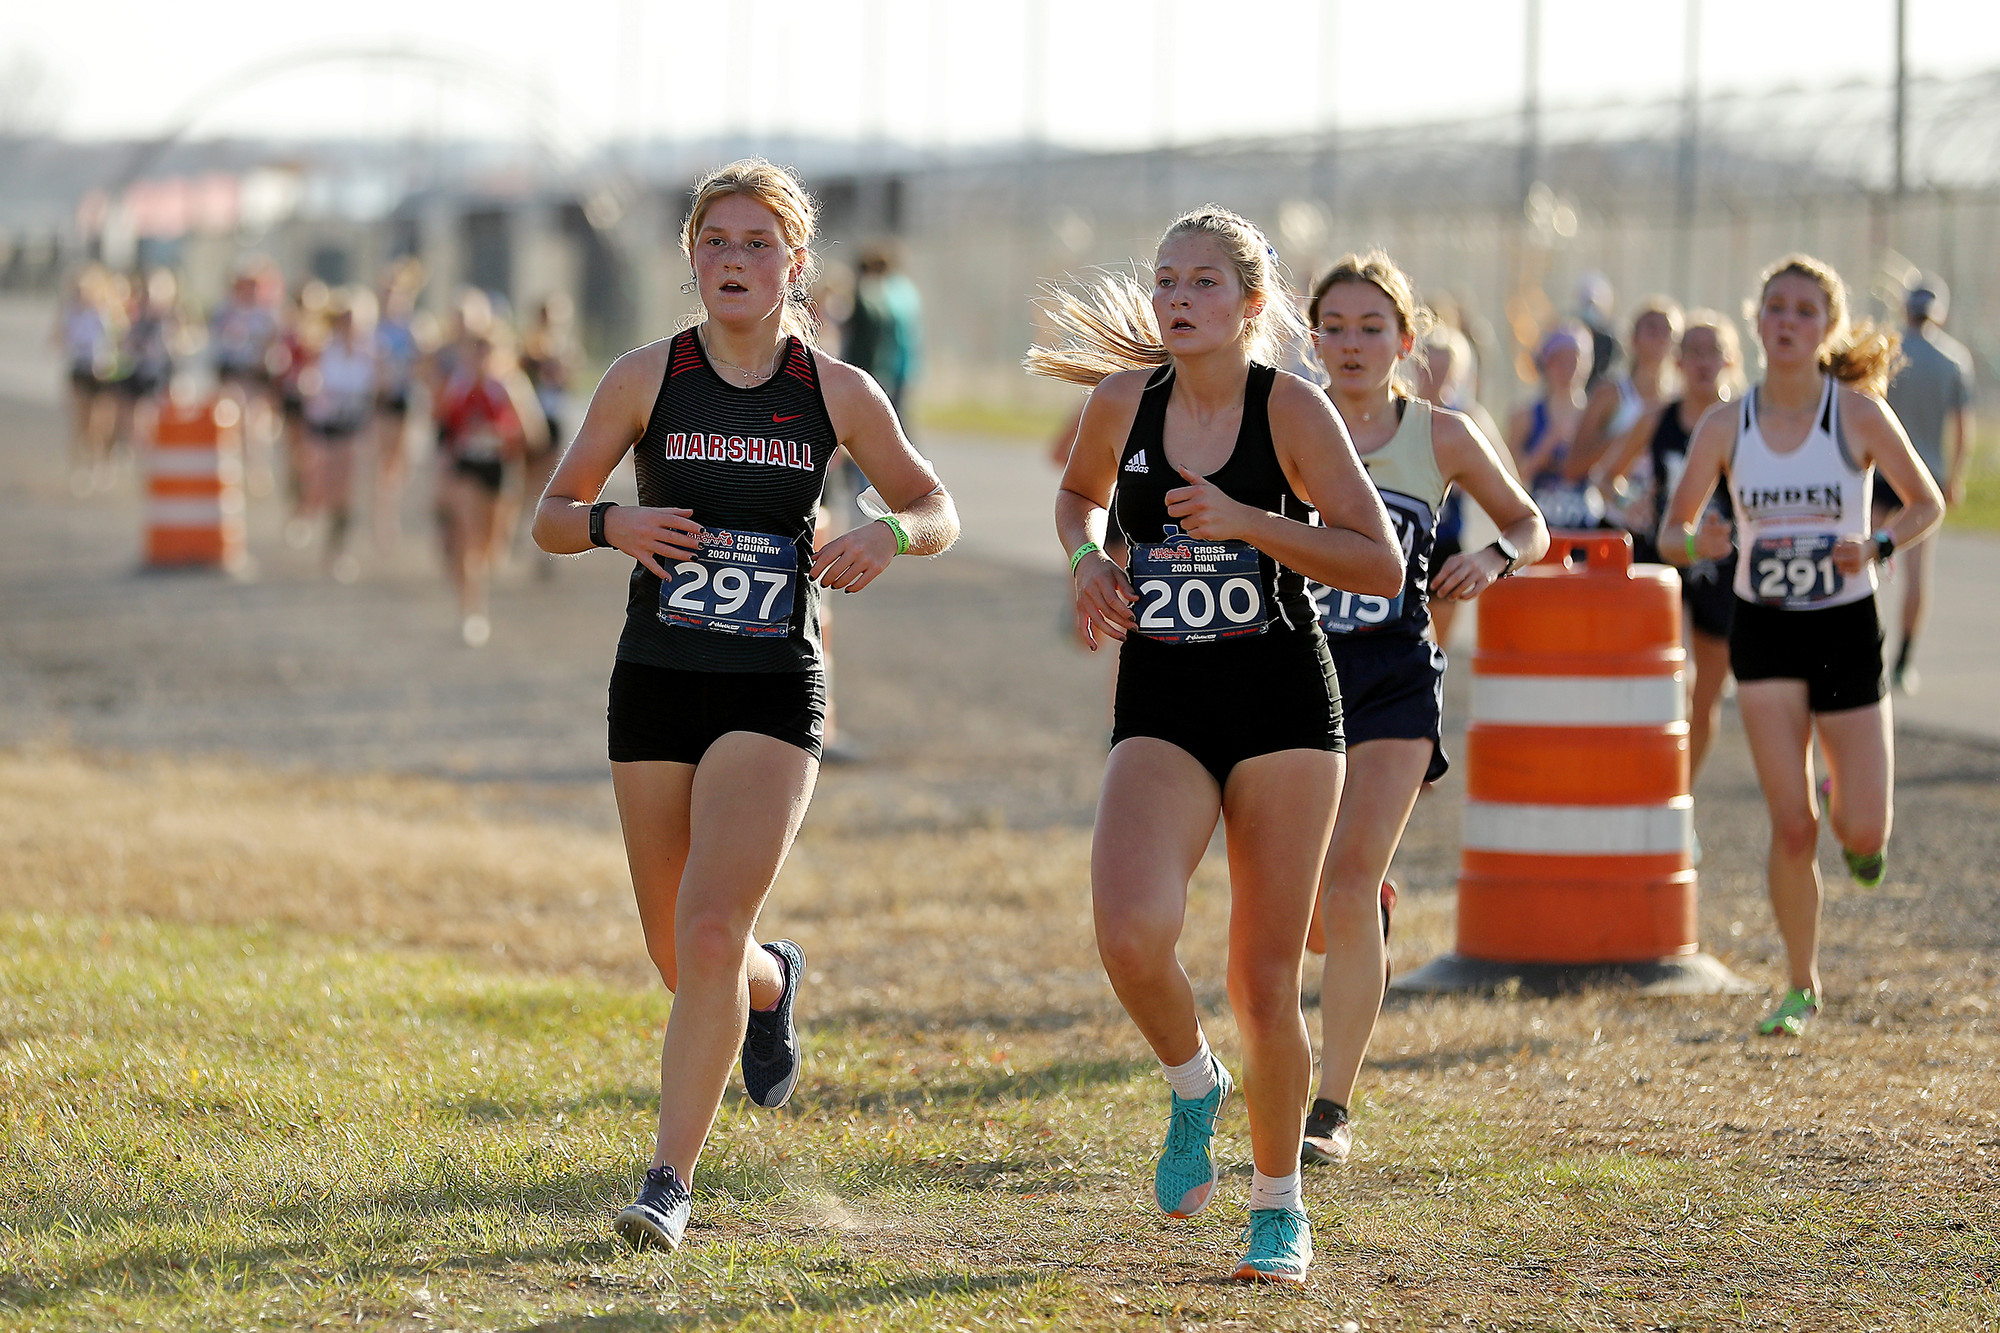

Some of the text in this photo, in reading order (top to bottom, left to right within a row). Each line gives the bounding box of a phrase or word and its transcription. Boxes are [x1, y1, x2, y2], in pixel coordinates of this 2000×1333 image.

[665, 432, 815, 472] MARSHALL
[1124, 463, 1150, 474] adidas
[1738, 482, 1843, 509] LINDEN
[737, 534, 770, 546] CROSS
[736, 543, 781, 555] COUNTRY
[1193, 545, 1226, 554] CROSS
[707, 549, 758, 563] 2020 FINAL
[1194, 553, 1239, 562] COUNTRY
[1171, 563, 1218, 573] 2020 FINAL
[1758, 556, 1836, 598] 291
[667, 561, 789, 620] 297
[1138, 577, 1261, 629] 200
